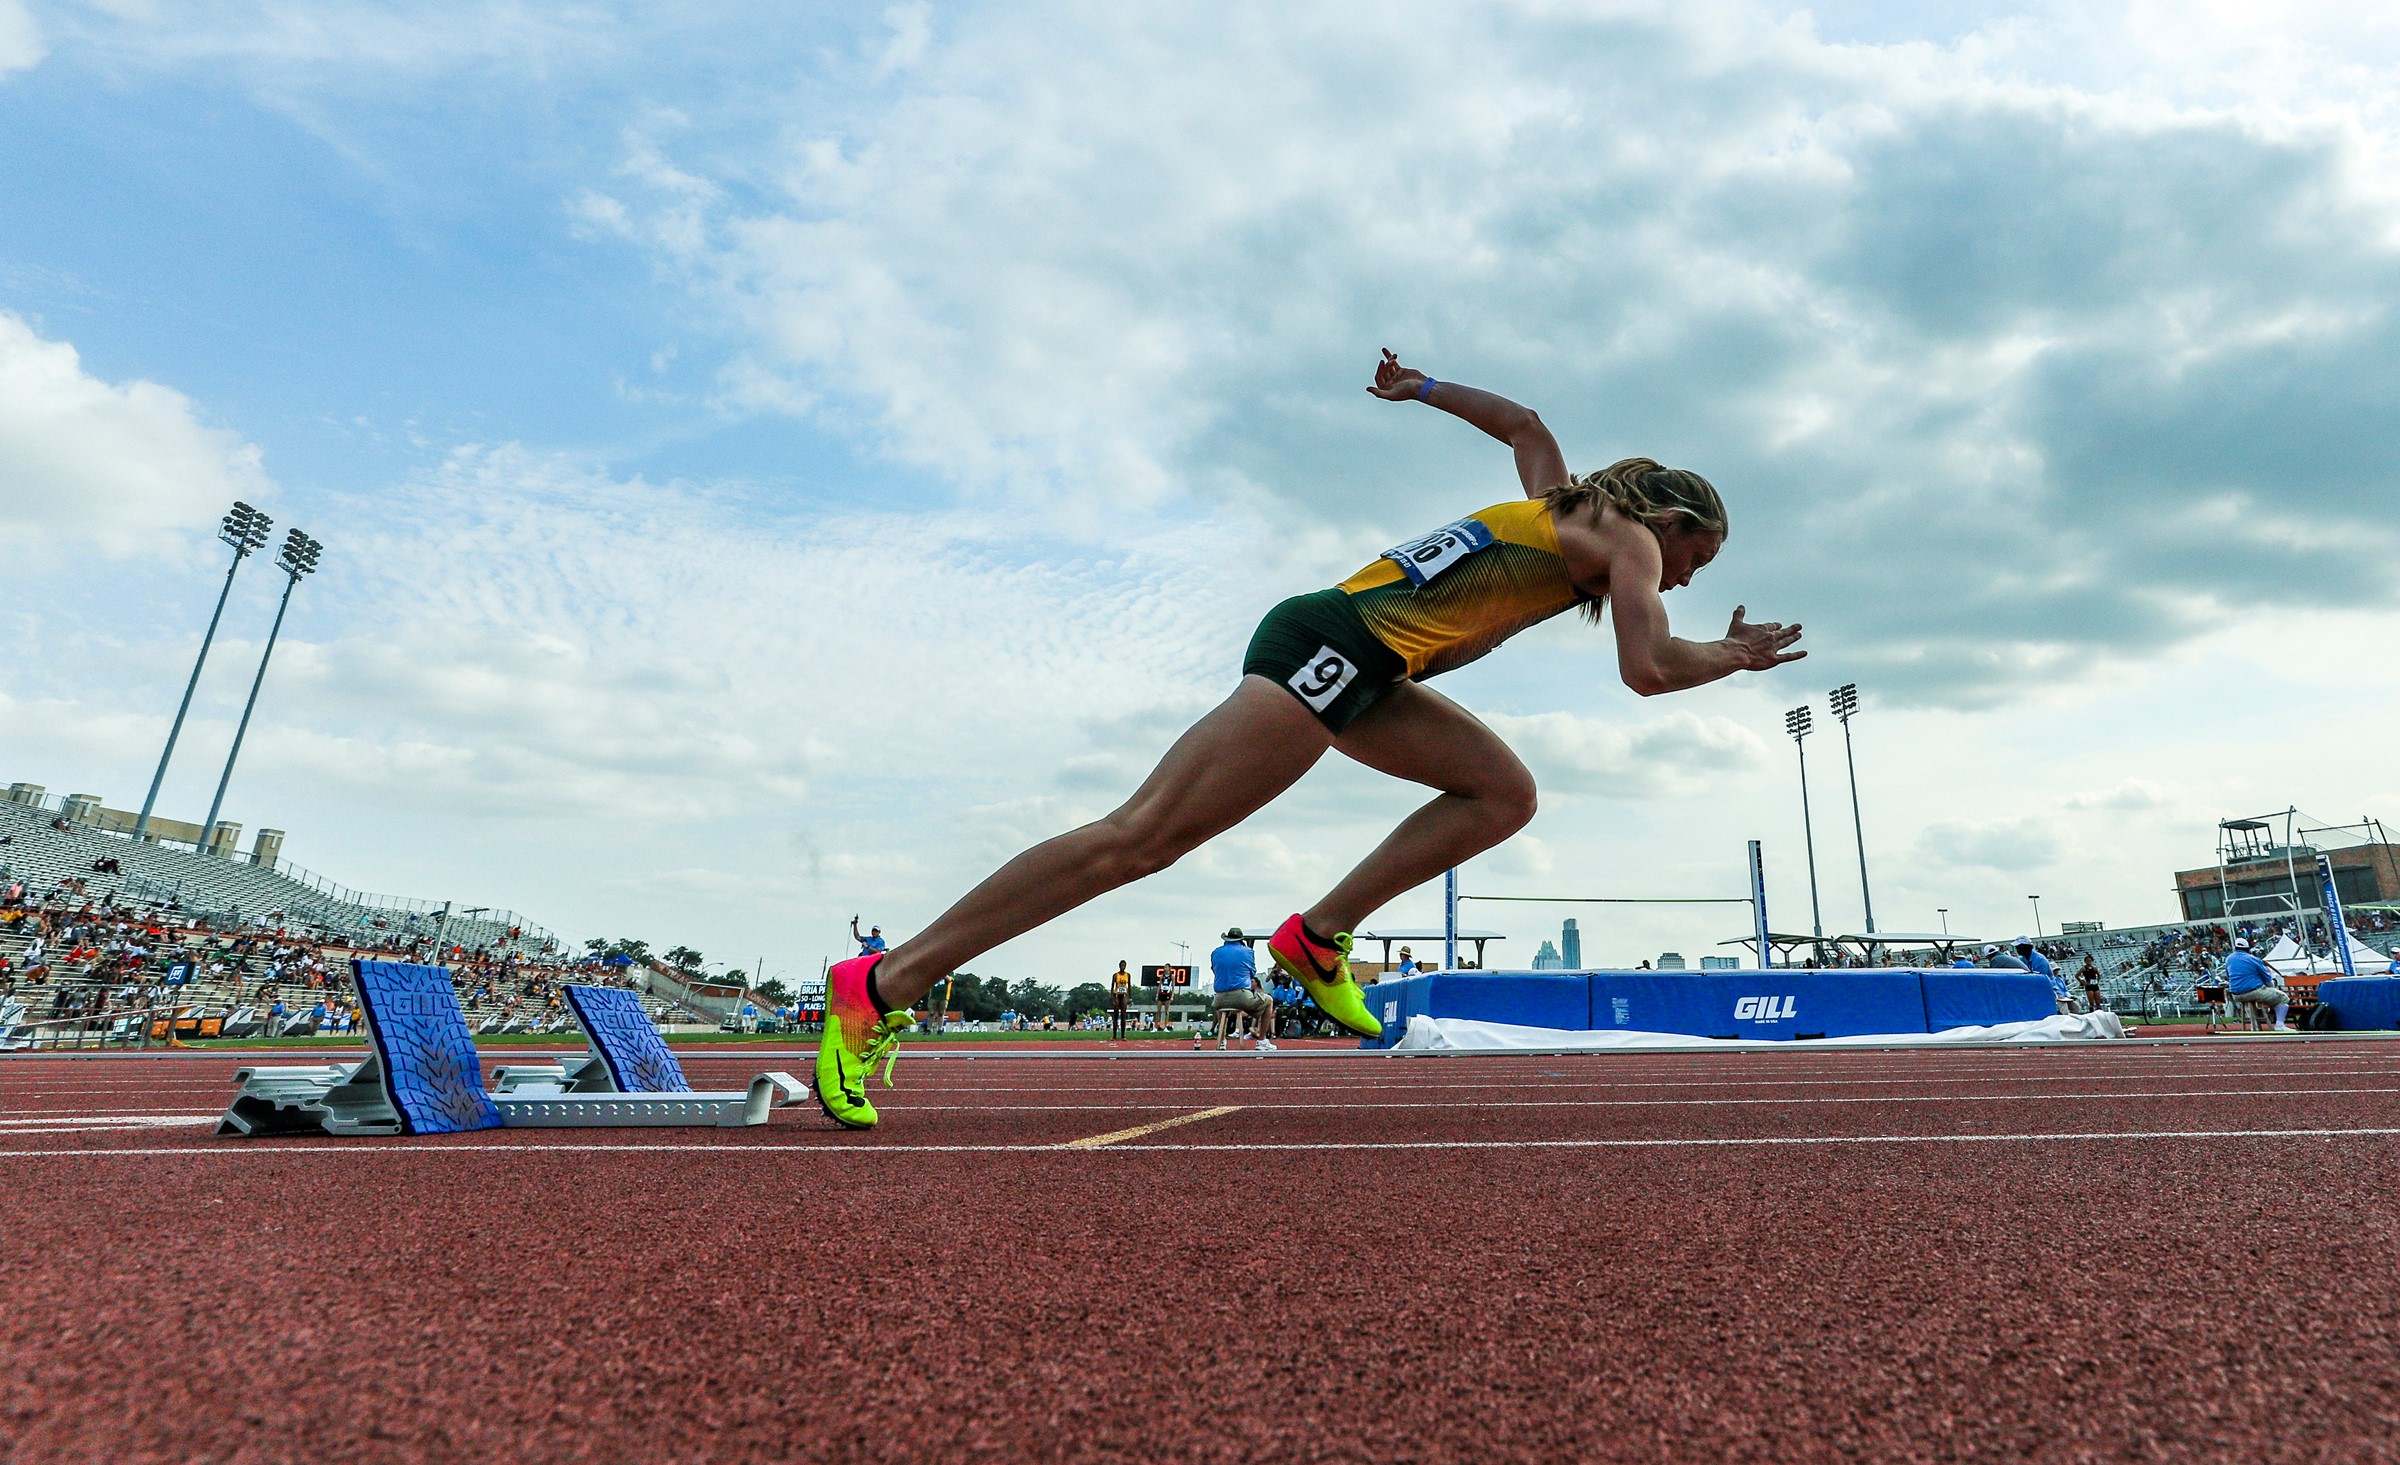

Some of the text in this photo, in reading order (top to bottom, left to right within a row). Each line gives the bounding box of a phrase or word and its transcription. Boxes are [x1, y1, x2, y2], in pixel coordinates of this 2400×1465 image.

[1298, 656, 1345, 697] 9
[802, 986, 818, 994] BRIA
[392, 994, 448, 1016] GILL
[1734, 996, 1797, 1019] GILL
[601, 1012, 645, 1030] GILL
[800, 1011, 819, 1020] X X
